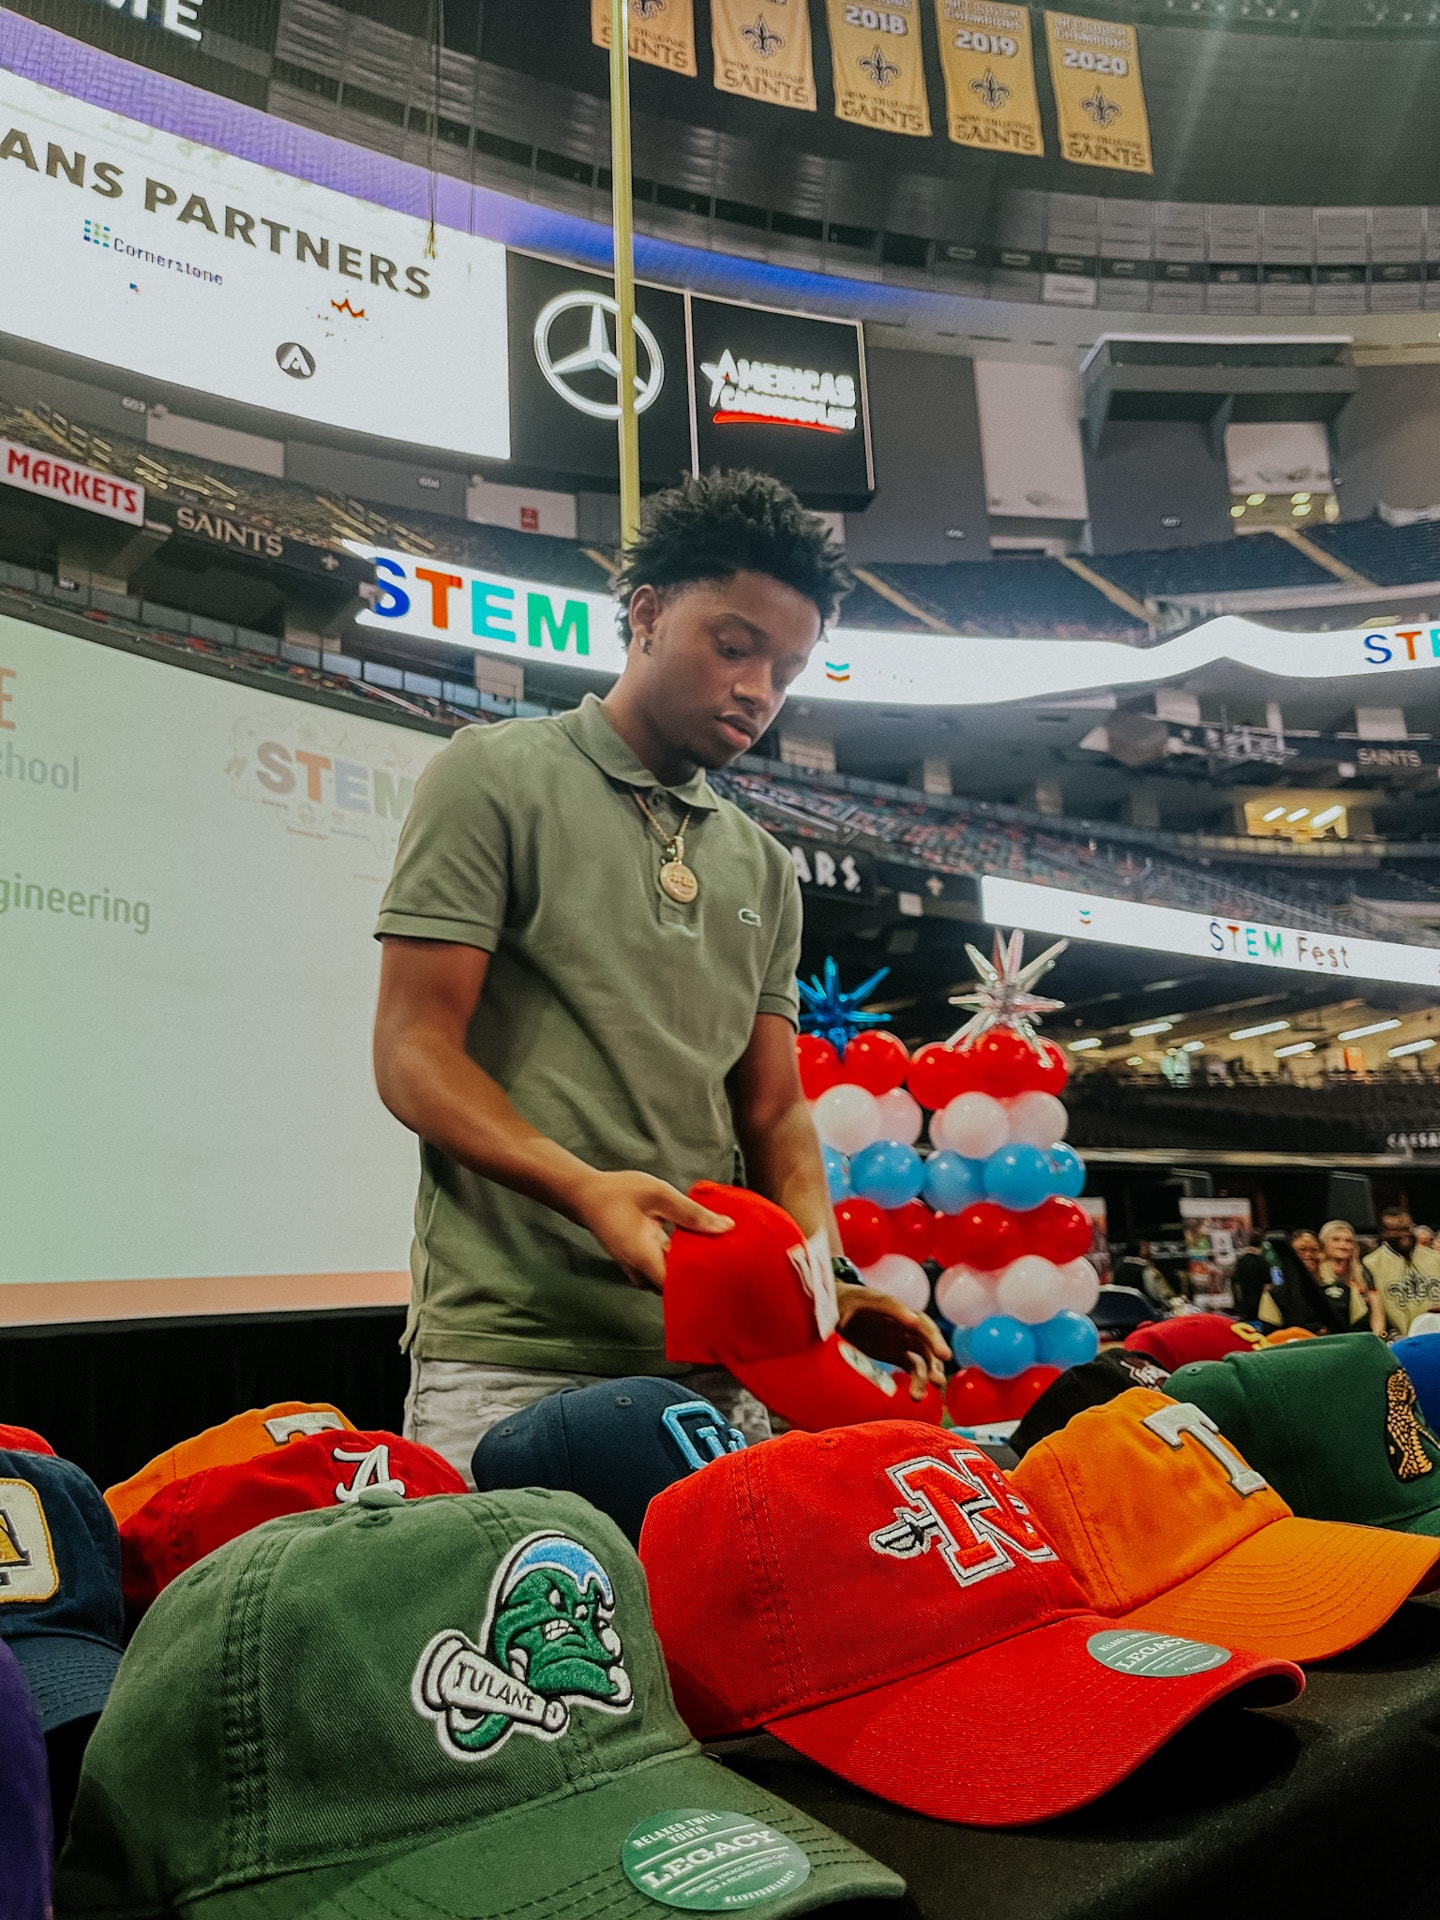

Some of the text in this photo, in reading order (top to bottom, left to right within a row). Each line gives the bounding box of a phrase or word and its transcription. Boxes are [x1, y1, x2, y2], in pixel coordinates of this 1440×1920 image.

[845, 4, 908, 36] 2018
[602, 26, 689, 69] SINTS
[954, 29, 1018, 58] 2019
[1063, 48, 1129, 77] 2020
[724, 68, 809, 104] SAINTS
[842, 99, 924, 133] SAINTS
[955, 124, 1037, 151] SAINTS
[1068, 141, 1146, 167] SAINTS
[0, 128, 431, 300] ANS PARTNERS
[6, 446, 139, 514] MARKETS
[176, 506, 284, 557] SAINTS
[374, 556, 590, 656] STEM
[0, 741, 80, 793] hool
[1356, 748, 1422, 768] SAINTS
[1208, 921, 1350, 970] STEM Fest
[1114, 1637, 1194, 1670] LEGACY
[632, 1813, 723, 1849] RELAXED TWILL
[668, 1825, 708, 1844] YOUTH
[640, 1829, 777, 1889] LEGACY
